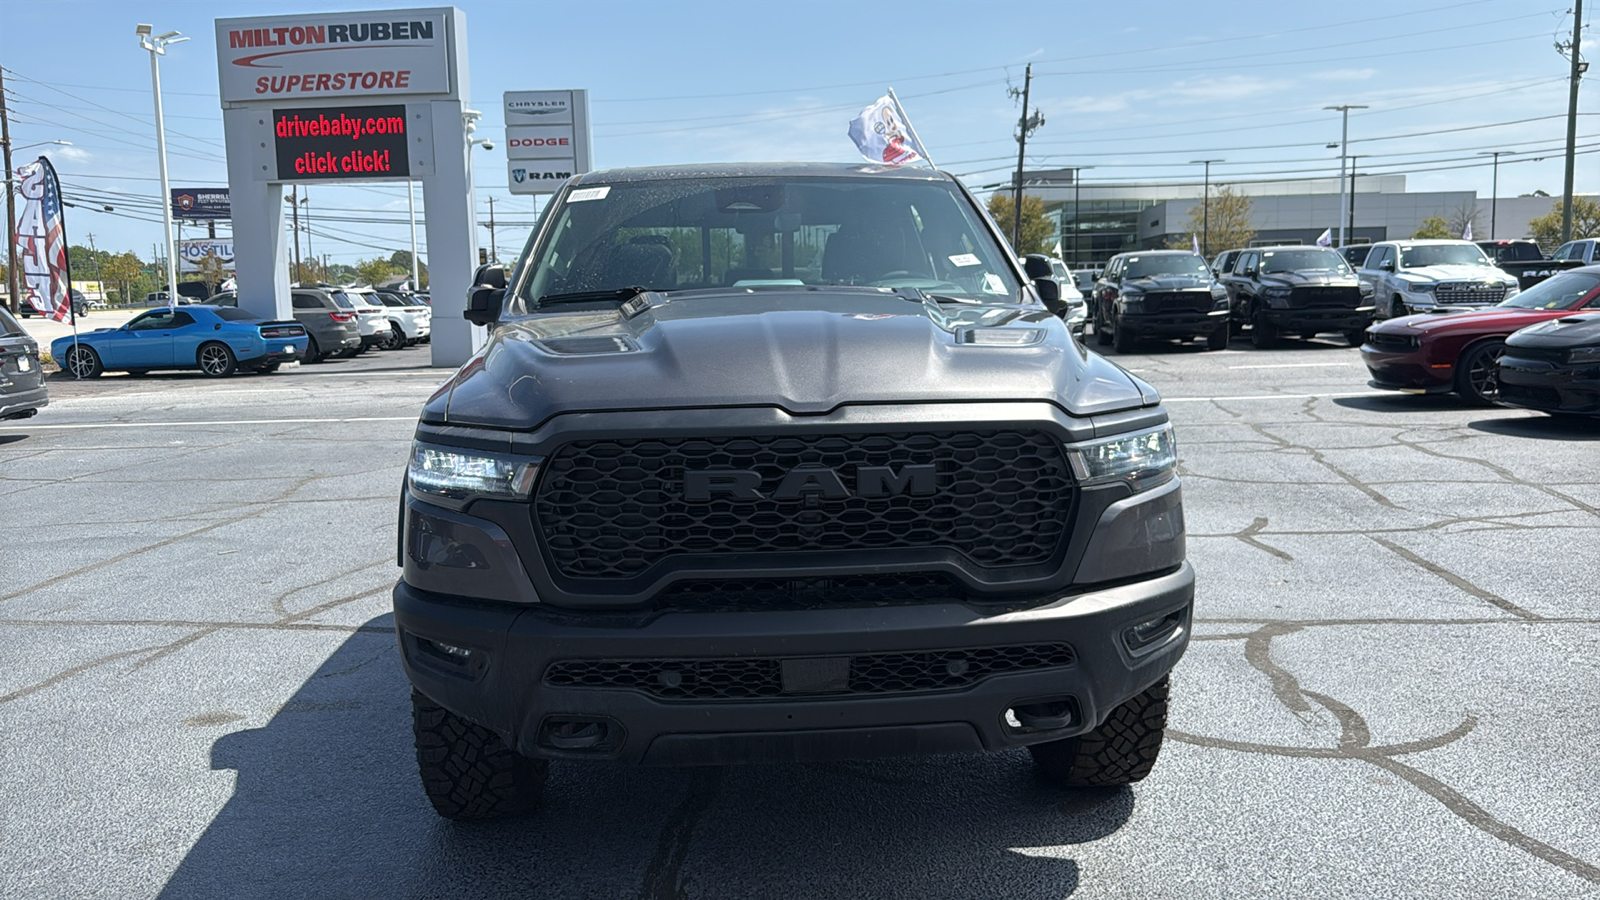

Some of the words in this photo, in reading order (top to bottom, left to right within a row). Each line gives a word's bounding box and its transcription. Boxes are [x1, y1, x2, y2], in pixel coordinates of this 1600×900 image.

[229, 26, 325, 49] MILTON
[328, 21, 434, 43] RUBEN
[255, 70, 411, 94] SUPERSTORE
[508, 100, 566, 108] CHRYSLER
[276, 113, 404, 140] drivebaby.com
[509, 138, 569, 147] DODGE
[295, 151, 338, 175] click
[341, 149, 390, 173] click!
[529, 172, 571, 180] RAM
[180, 244, 235, 257] HOSTIL
[684, 463, 937, 501] RAM
